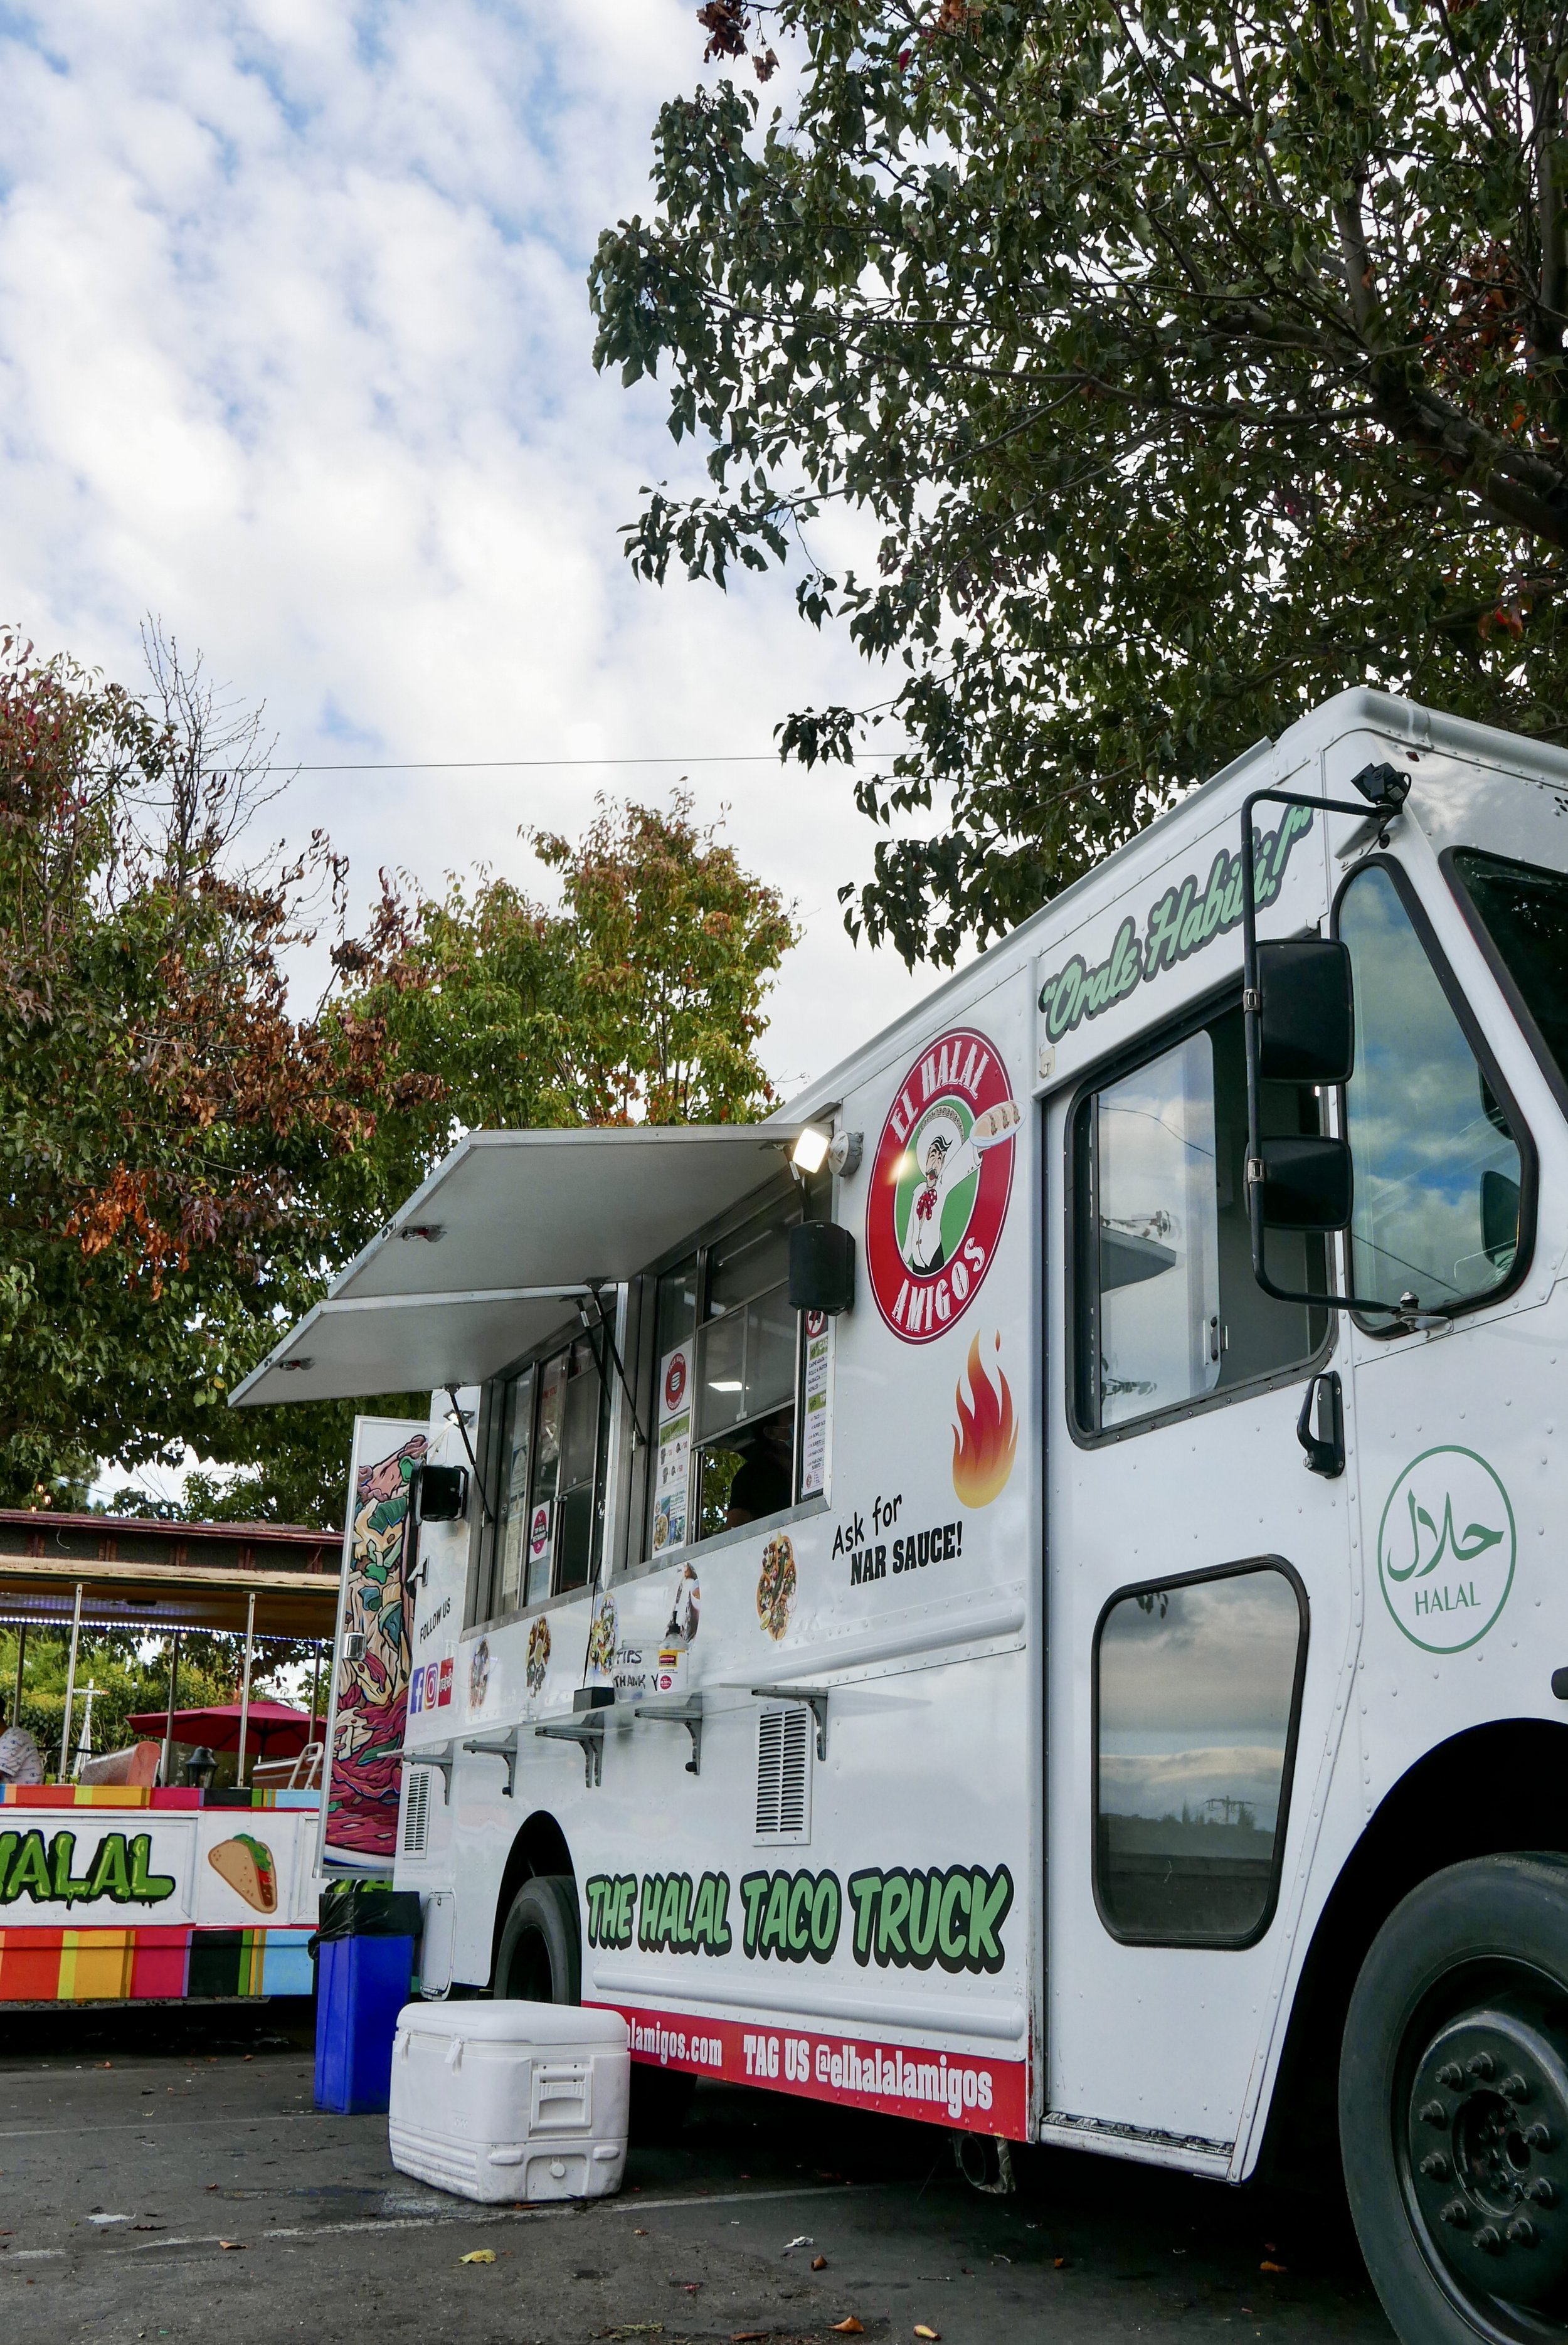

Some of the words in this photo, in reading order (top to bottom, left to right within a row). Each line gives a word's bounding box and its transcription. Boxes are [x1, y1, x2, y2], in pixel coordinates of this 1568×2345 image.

[890, 1091, 919, 1144] EL
[920, 1040, 990, 1101] HALAL
[891, 1237, 986, 1333] AMIGOS
[832, 1511, 865, 1560] Ask
[872, 1494, 902, 1536] for
[850, 1545, 887, 1586] NAR
[893, 1520, 963, 1574] SAUCE!
[1387, 1488, 1505, 1582] حلال
[420, 1606, 442, 1644] FOLLOW
[443, 1597, 451, 1619] US
[1414, 1581, 1481, 1616] HALAL
[613, 1674, 646, 1690] THANK
[616, 1649, 643, 1665] TIPS
[586, 1872, 638, 1949] THE
[638, 1871, 731, 1957] HALAL
[739, 1868, 842, 1965] TACO
[847, 1863, 1014, 1974] TRUCK
[743, 2034, 780, 2078] TAG
[785, 2038, 810, 2083] US
[815, 2043, 993, 2119] @elhalalamigos
